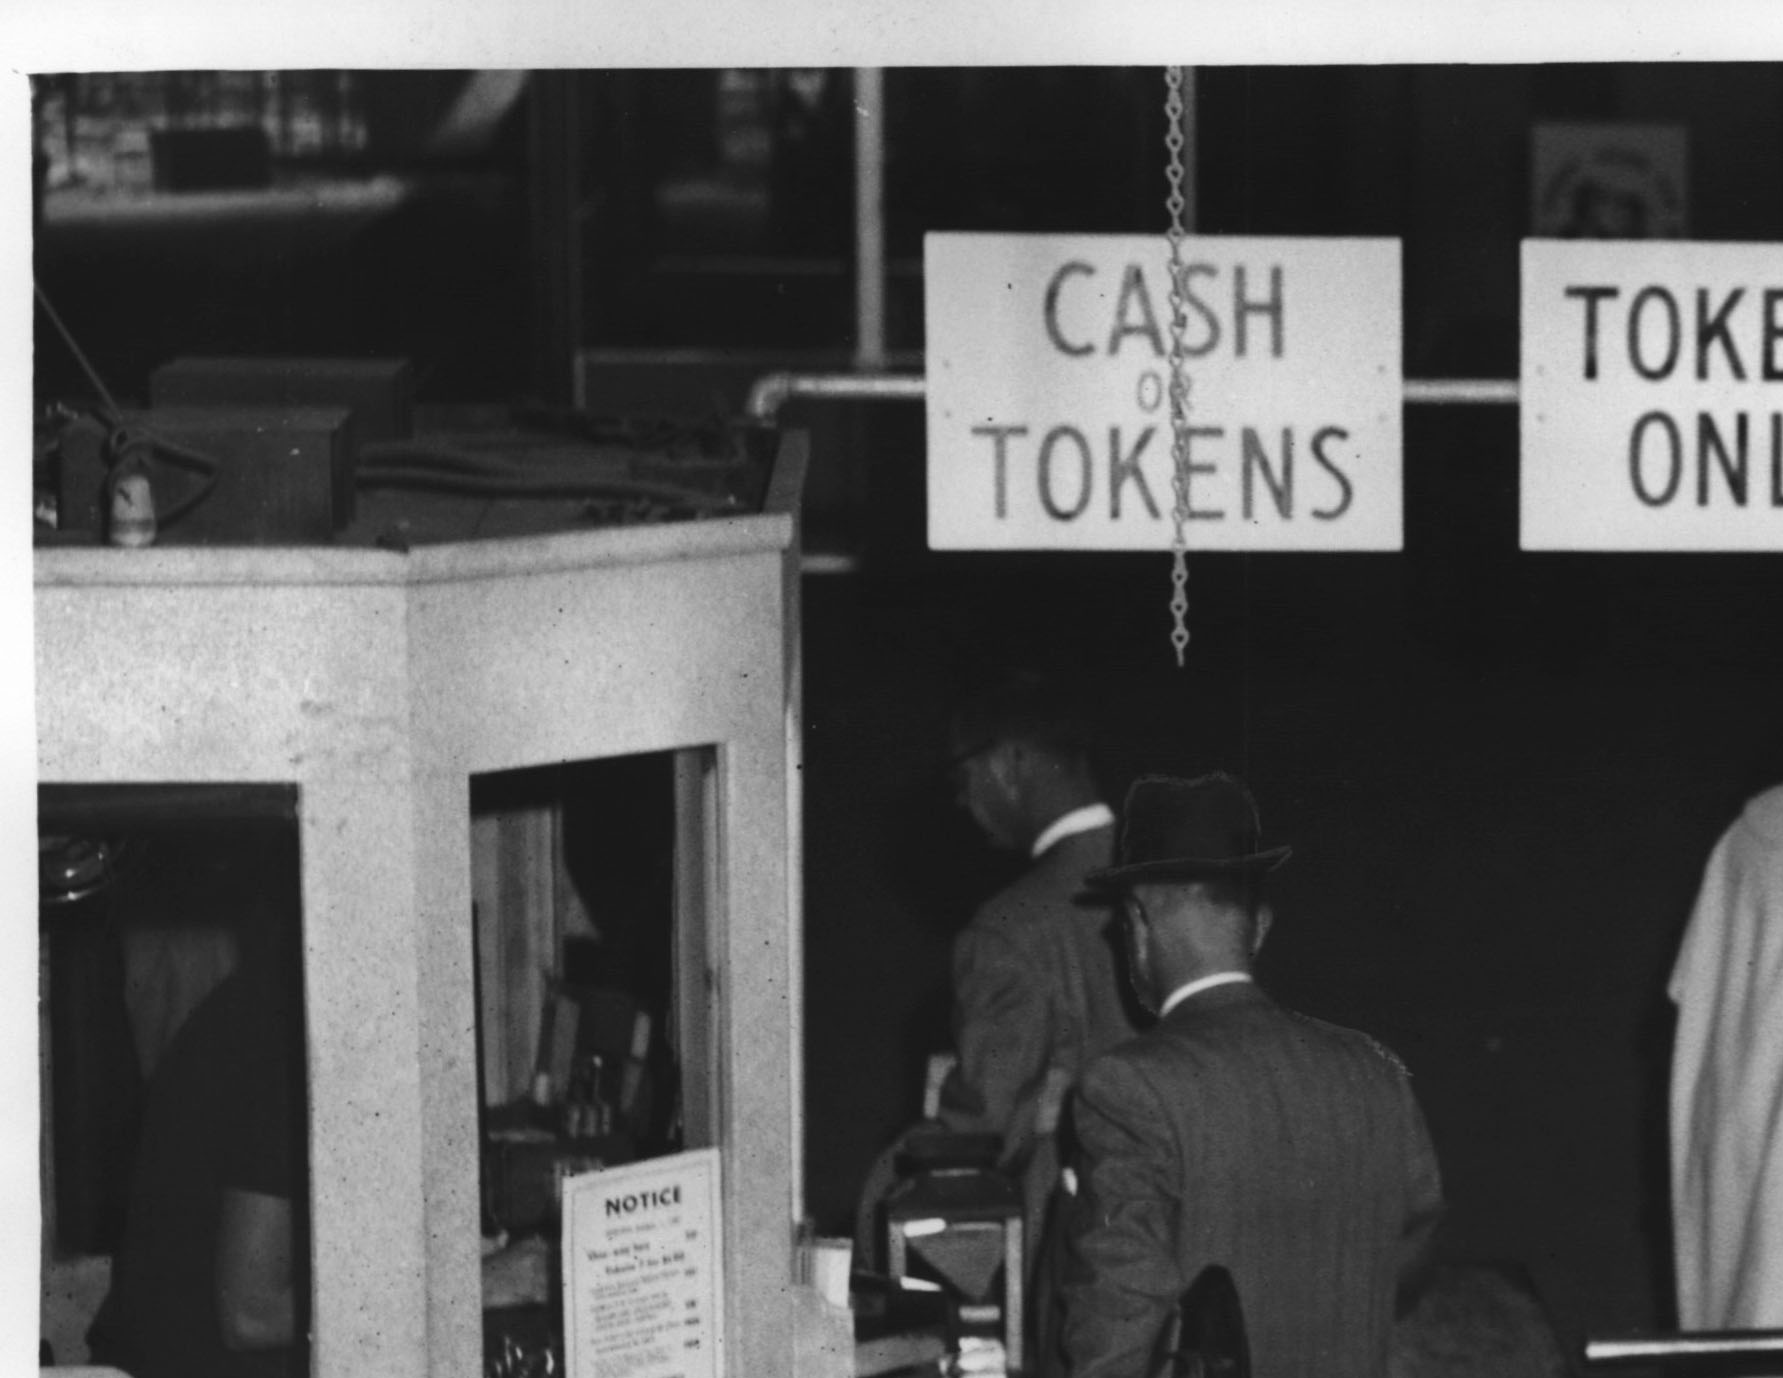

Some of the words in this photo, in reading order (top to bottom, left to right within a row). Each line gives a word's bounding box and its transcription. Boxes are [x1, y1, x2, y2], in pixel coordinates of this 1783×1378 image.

[1043, 260, 1284, 359] CASH
[970, 424, 1354, 524] TOKENS
[605, 1185, 681, 1217] NOTICE
